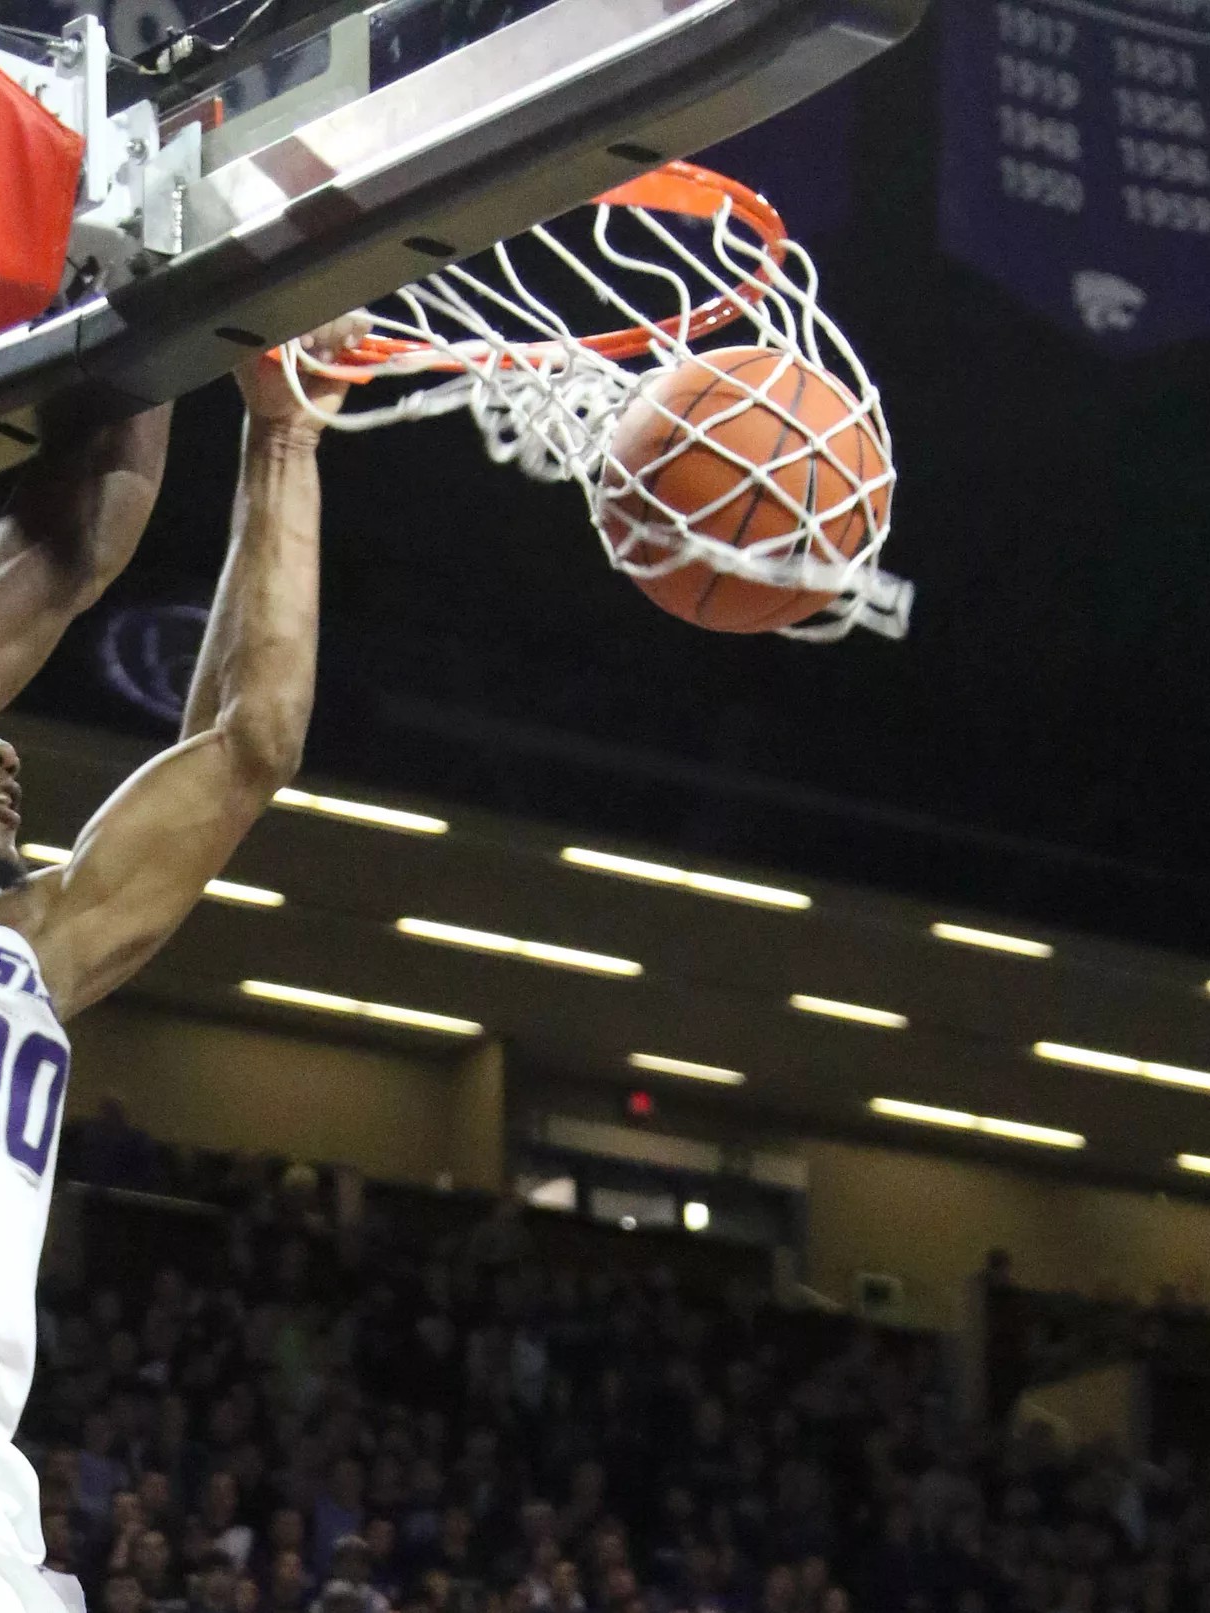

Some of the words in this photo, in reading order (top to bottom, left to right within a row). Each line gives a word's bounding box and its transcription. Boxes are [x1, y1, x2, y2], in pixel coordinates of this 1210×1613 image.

[996, 4, 1077, 56] 1917
[996, 55, 1081, 110] 1919
[1113, 37, 1197, 88] 1951
